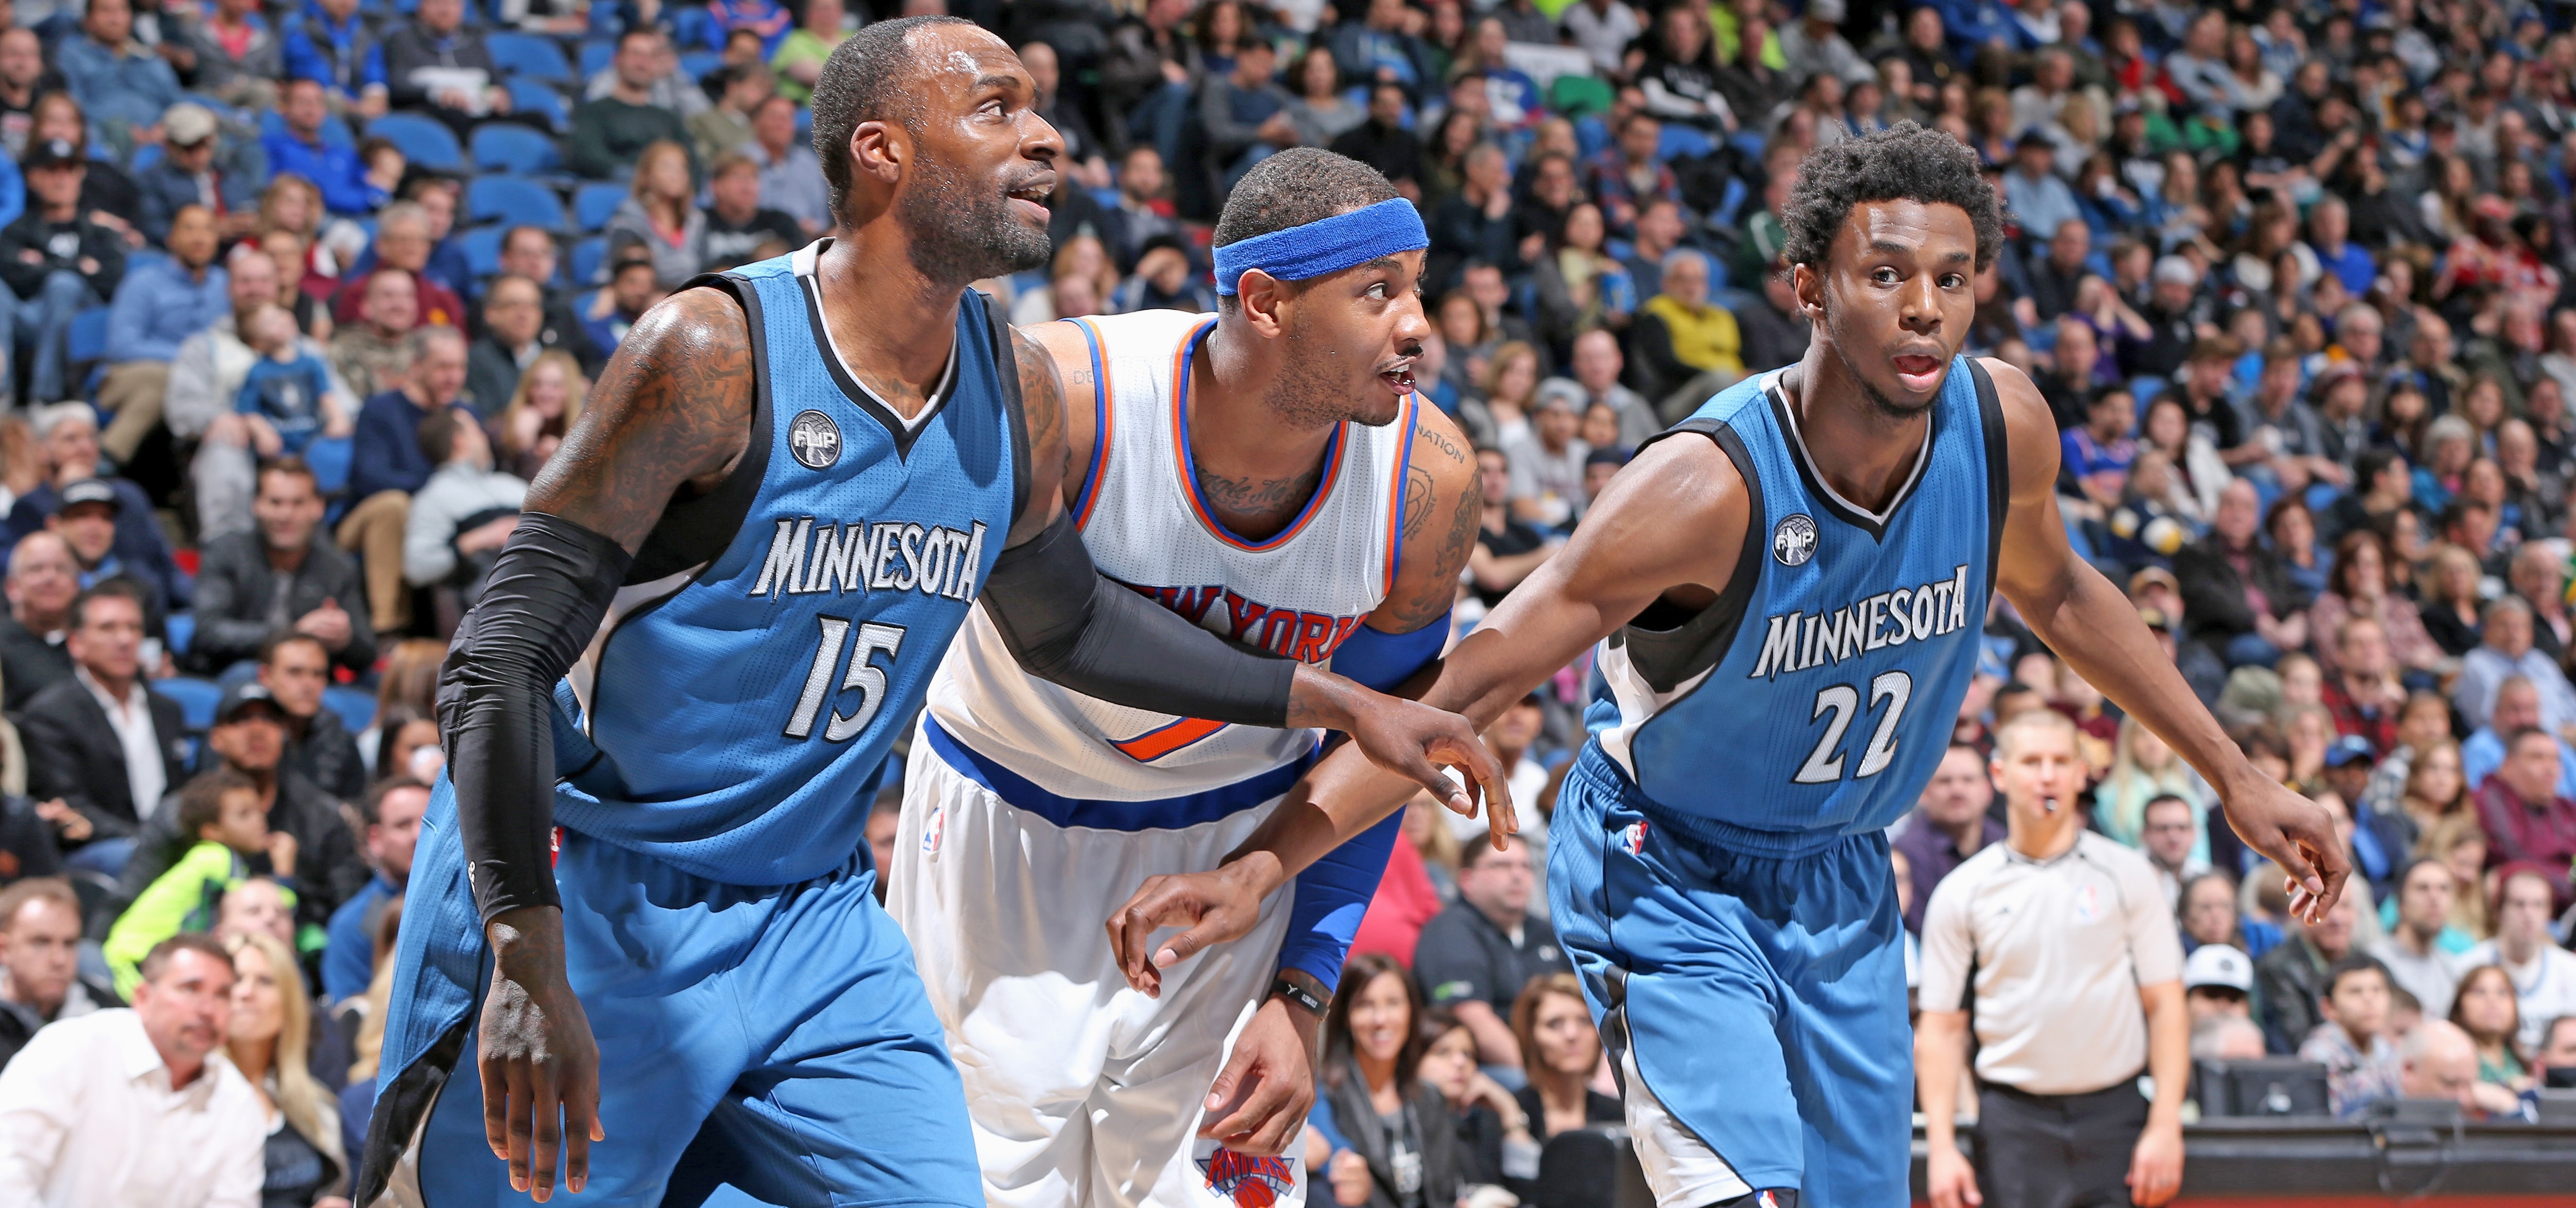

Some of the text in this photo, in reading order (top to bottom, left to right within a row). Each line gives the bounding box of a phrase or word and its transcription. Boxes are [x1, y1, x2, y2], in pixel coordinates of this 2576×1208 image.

[1416, 422, 1465, 464] NATION
[749, 515, 987, 604] MINNESOTA
[782, 612, 908, 744] 15
[1748, 564, 1968, 682] MINNESOTA
[1790, 669, 1913, 784] 22
